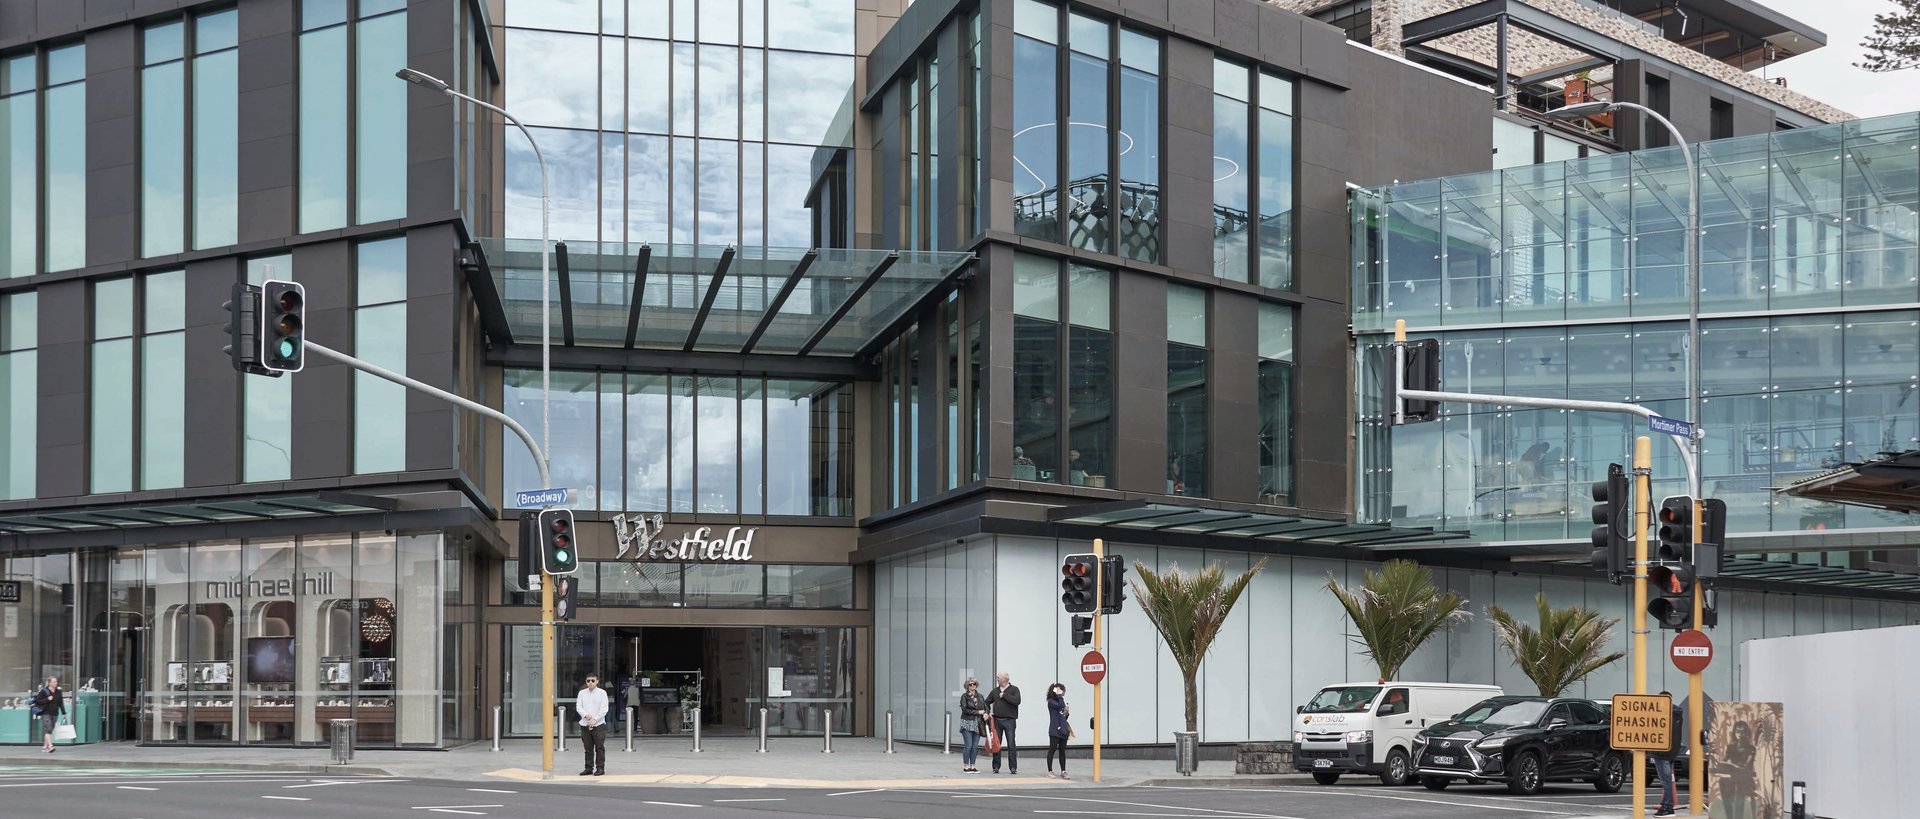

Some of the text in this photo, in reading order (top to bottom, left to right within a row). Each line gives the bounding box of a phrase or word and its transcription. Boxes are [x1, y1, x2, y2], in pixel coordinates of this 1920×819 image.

[1651, 417, 1689, 435] Mortimer Pass
[521, 492, 562, 504] Broadway
[608, 512, 759, 561] Westfield
[206, 571, 333, 599] michael hill
[1621, 700, 1662, 713] SIGNAL
[1312, 714, 1345, 722] conslab
[1616, 716, 1666, 729] PHASING
[1617, 732, 1664, 744] CHANGE
